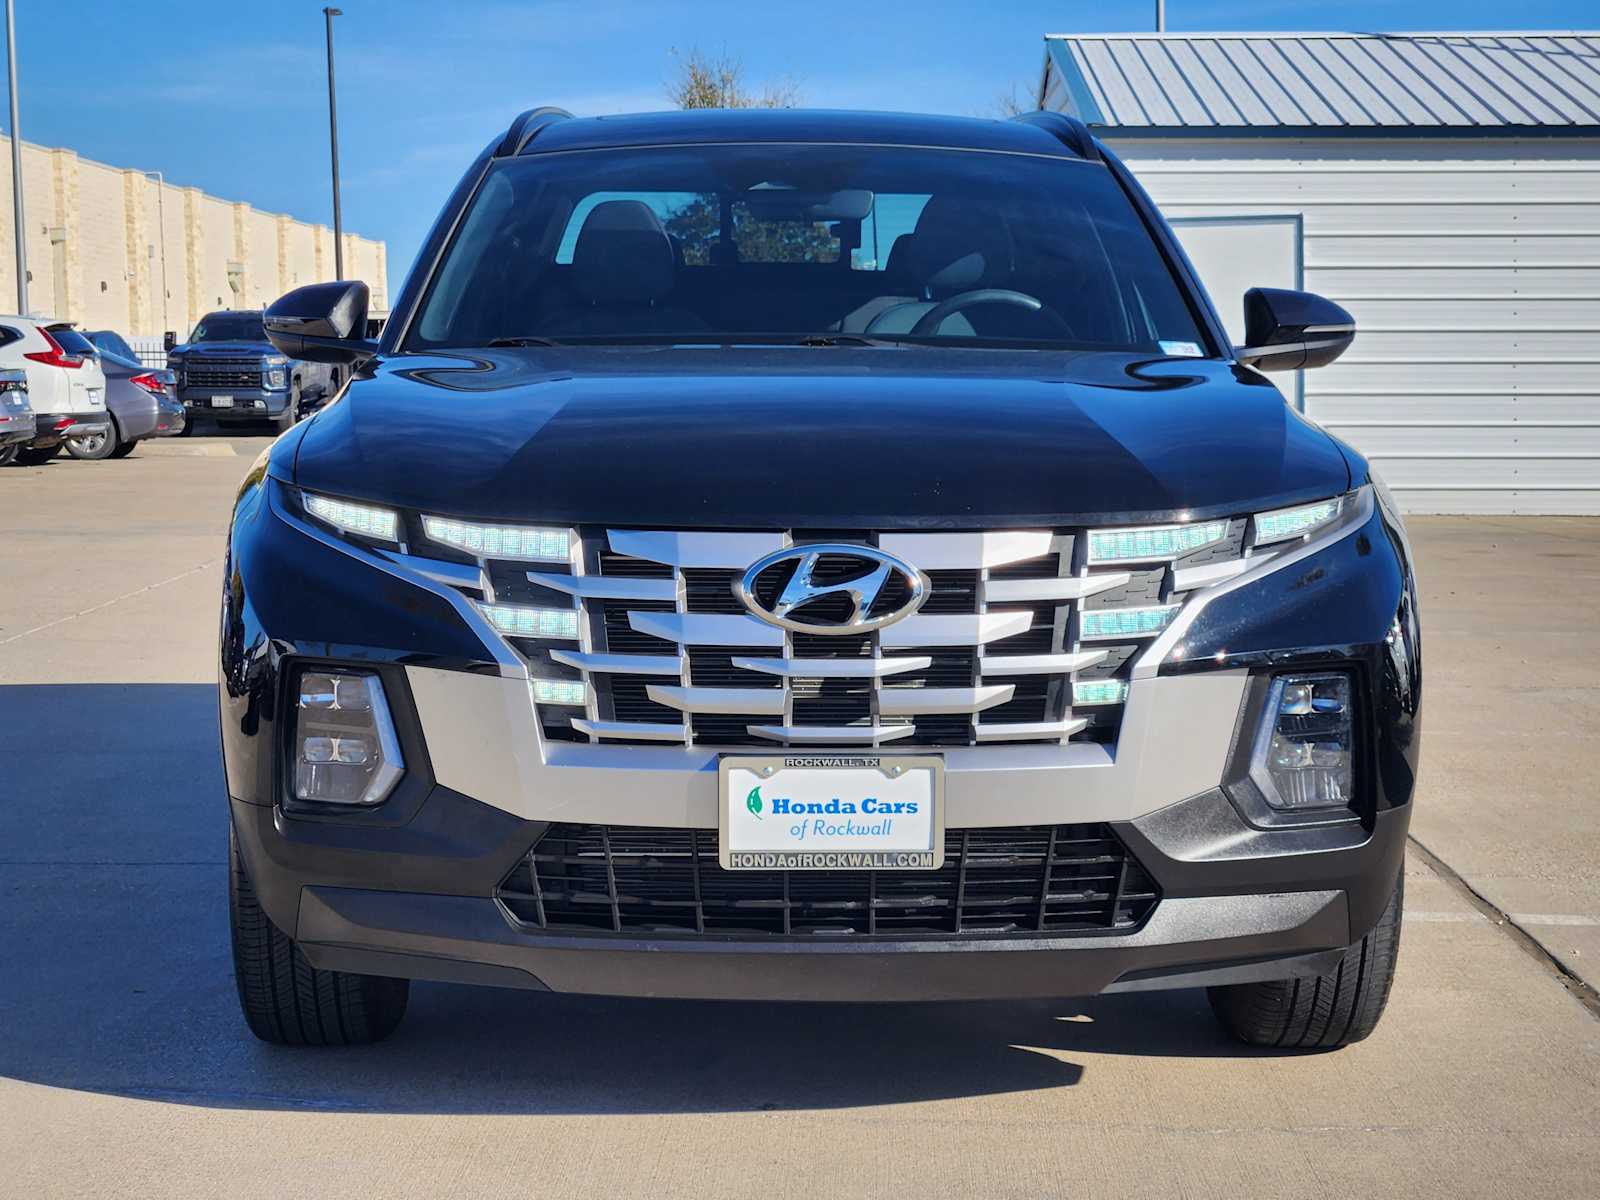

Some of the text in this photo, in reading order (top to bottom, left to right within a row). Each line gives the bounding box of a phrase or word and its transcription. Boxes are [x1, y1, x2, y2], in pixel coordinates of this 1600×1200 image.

[863, 759, 878, 767] TX
[772, 798, 918, 814] Honda Cars
[790, 819, 892, 840] of Rockwall
[731, 853, 933, 867] HONDAofROCKWALL.COM
